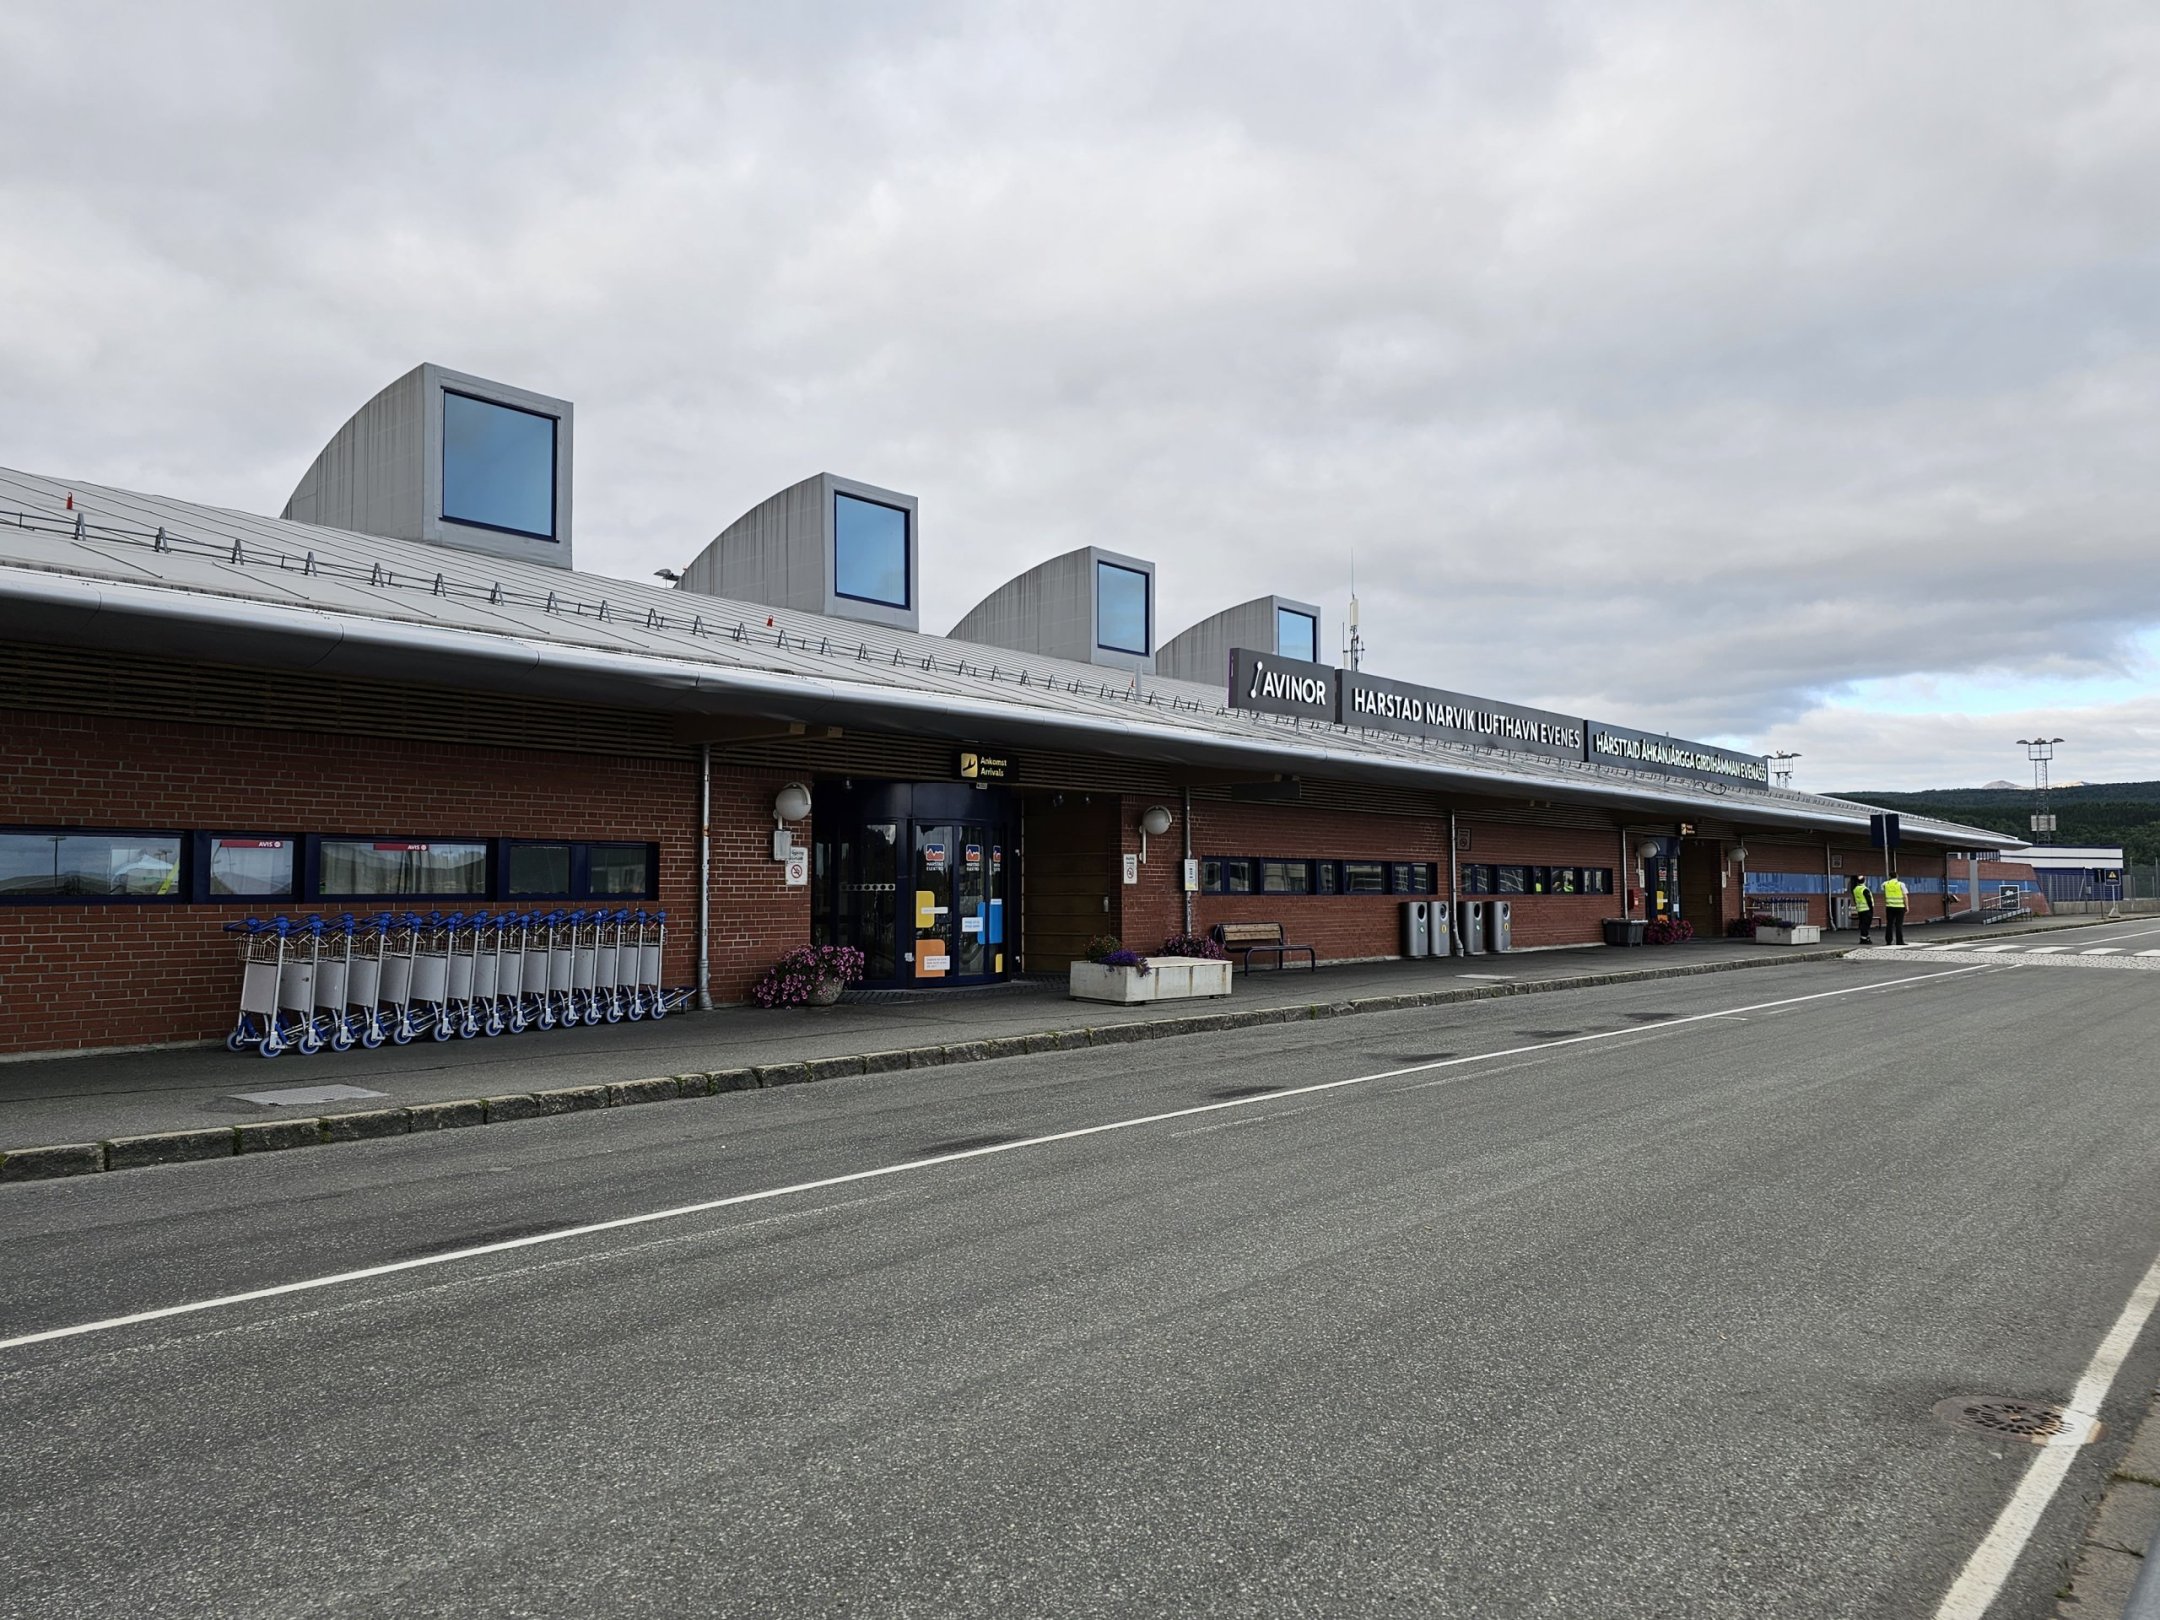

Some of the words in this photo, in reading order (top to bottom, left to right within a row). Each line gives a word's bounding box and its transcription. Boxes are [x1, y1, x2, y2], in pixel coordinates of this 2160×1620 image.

[1262, 671, 1327, 706] AVINOR
[1354, 687, 1422, 722] HARSTAD
[1425, 701, 1475, 732] NARVIK
[1478, 711, 1538, 742] LUFTHAVN
[1540, 723, 1580, 749] EVENES
[980, 756, 1007, 767] Ankomst
[980, 767, 1004, 777] Arrivals
